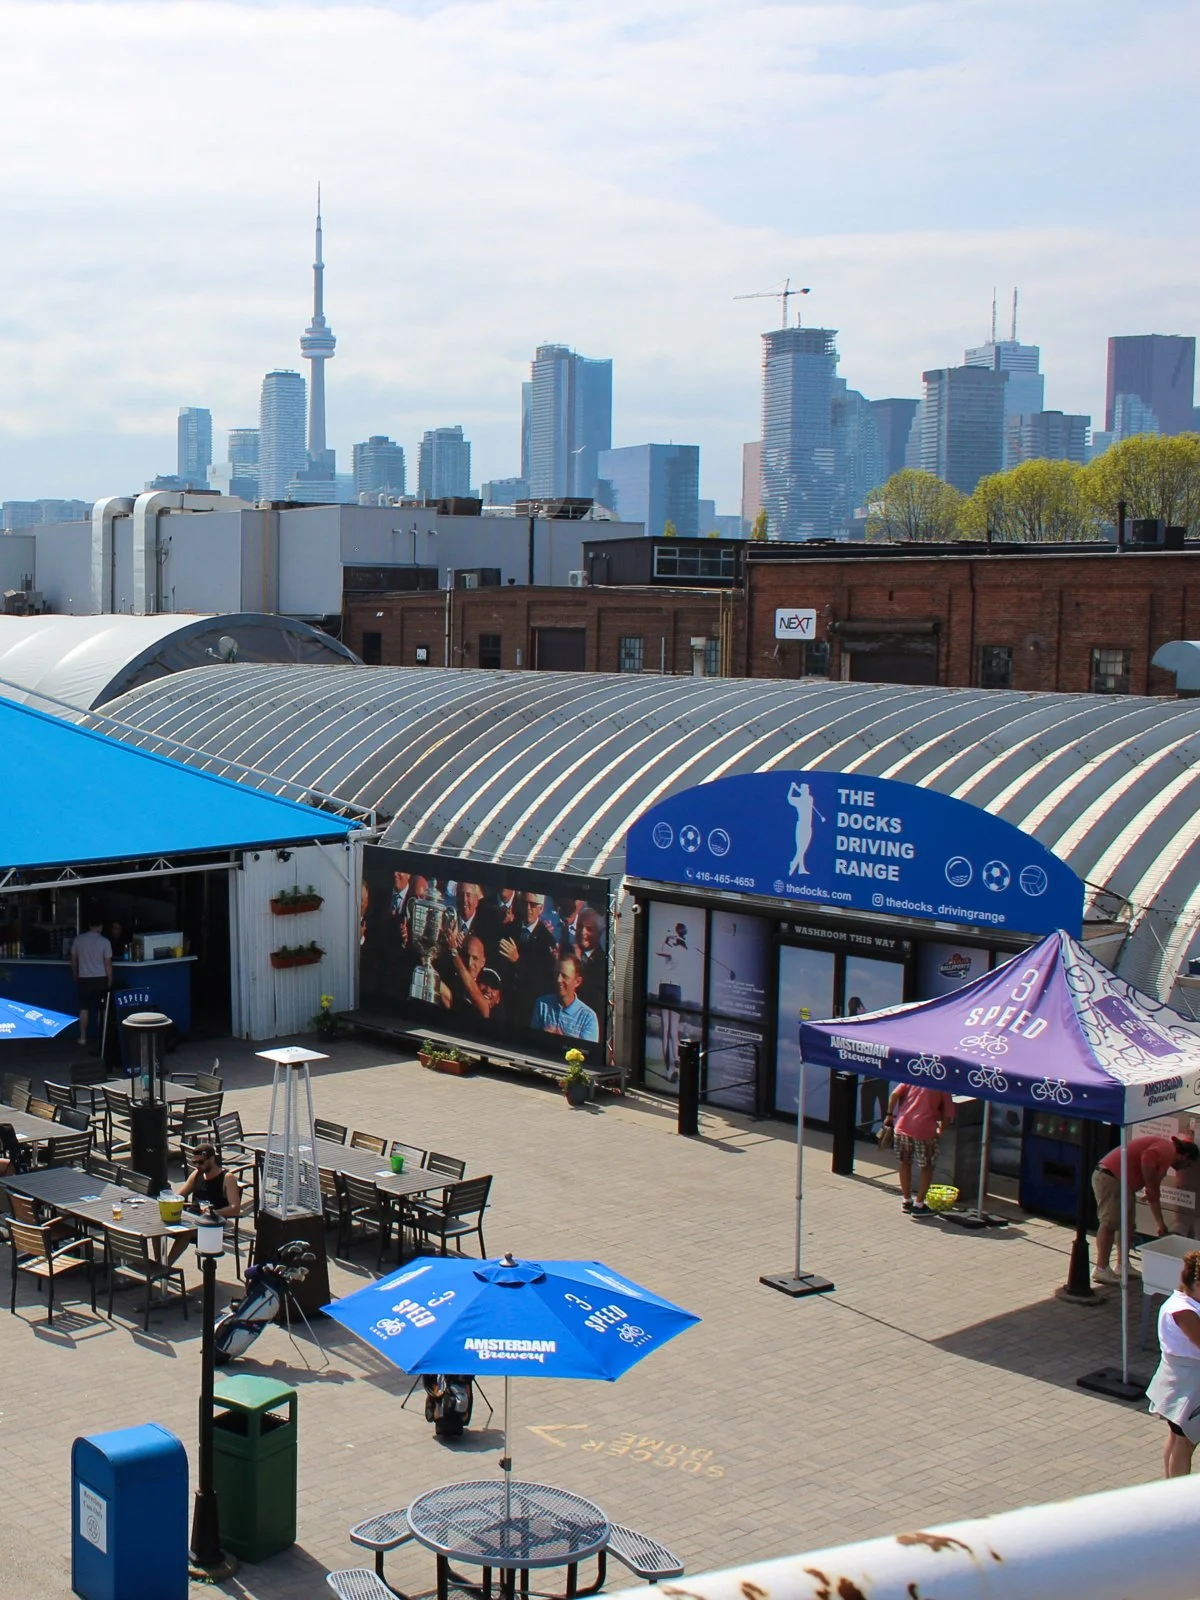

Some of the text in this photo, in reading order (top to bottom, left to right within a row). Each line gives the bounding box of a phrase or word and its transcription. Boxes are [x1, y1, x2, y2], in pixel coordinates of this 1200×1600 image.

[779, 614, 813, 634] NEXT
[838, 789, 875, 807] THE
[837, 812, 902, 833] DOCKS
[836, 835, 914, 859] DRIVING
[695, 871, 755, 888] 416-465-4653
[835, 859, 900, 881] RANGE
[886, 897, 1005, 923] thedocks_drivingrange
[794, 925, 896, 948] WASHROOM THIS WAY
[1010, 968, 1039, 1001] 3
[964, 1005, 1048, 1039] SPEED
[830, 1035, 890, 1058] AMSTERDAM
[838, 1049, 881, 1069] Brewery
[1143, 1075, 1184, 1097] AMSTERDAM
[427, 1290, 456, 1307] 3
[564, 1293, 593, 1311] 3
[392, 1299, 437, 1328] SPEED
[584, 1304, 629, 1333] SPEED
[464, 1338, 556, 1353] AMSTERDAM
[477, 1349, 544, 1364] Brewery
[620, 1432, 714, 1461] DOME
[581, 1439, 726, 1478] SOCCER
